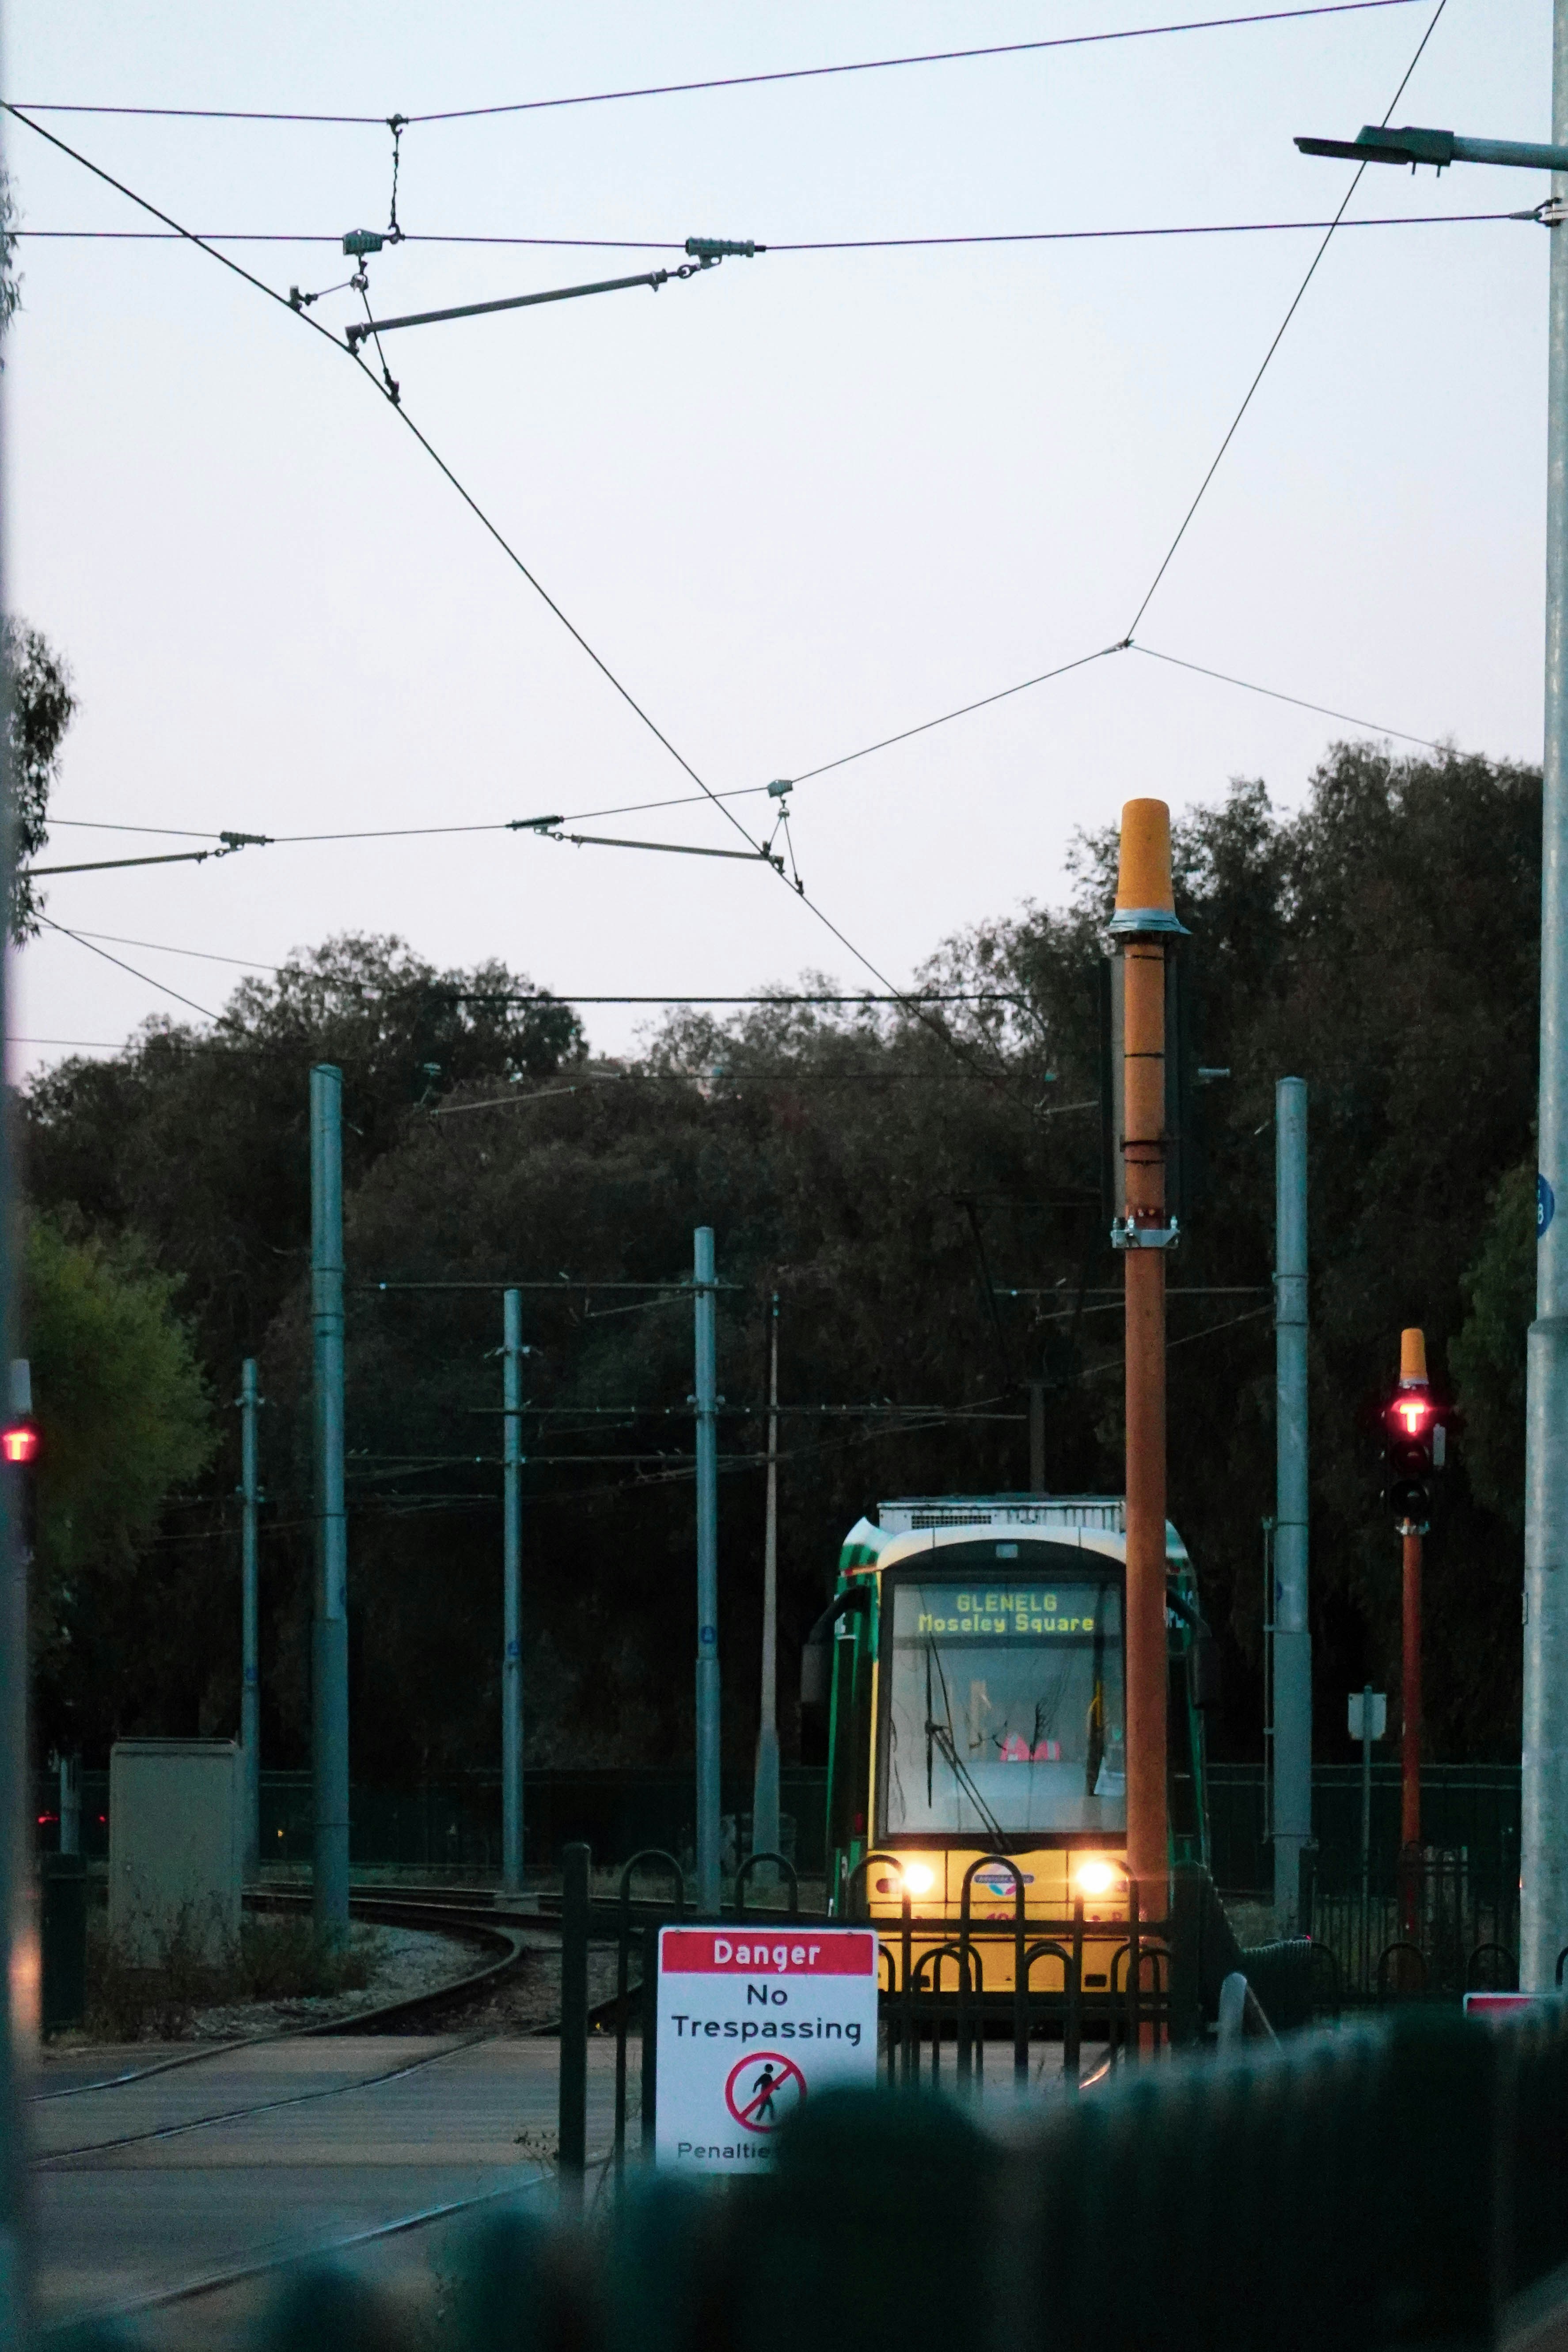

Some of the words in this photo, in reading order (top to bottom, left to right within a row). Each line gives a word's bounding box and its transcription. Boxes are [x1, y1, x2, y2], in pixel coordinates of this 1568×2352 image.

[1399, 1403, 1424, 1432] T
[957, 1594, 1057, 1612] GLENELG
[918, 1614, 1006, 1633] Moseley
[1016, 1613, 1094, 1633] Square
[714, 1939, 820, 1973] Danger
[747, 1984, 788, 2006] No
[671, 2015, 862, 2047] Trespassing
[678, 2142, 774, 2158] Penaltie
